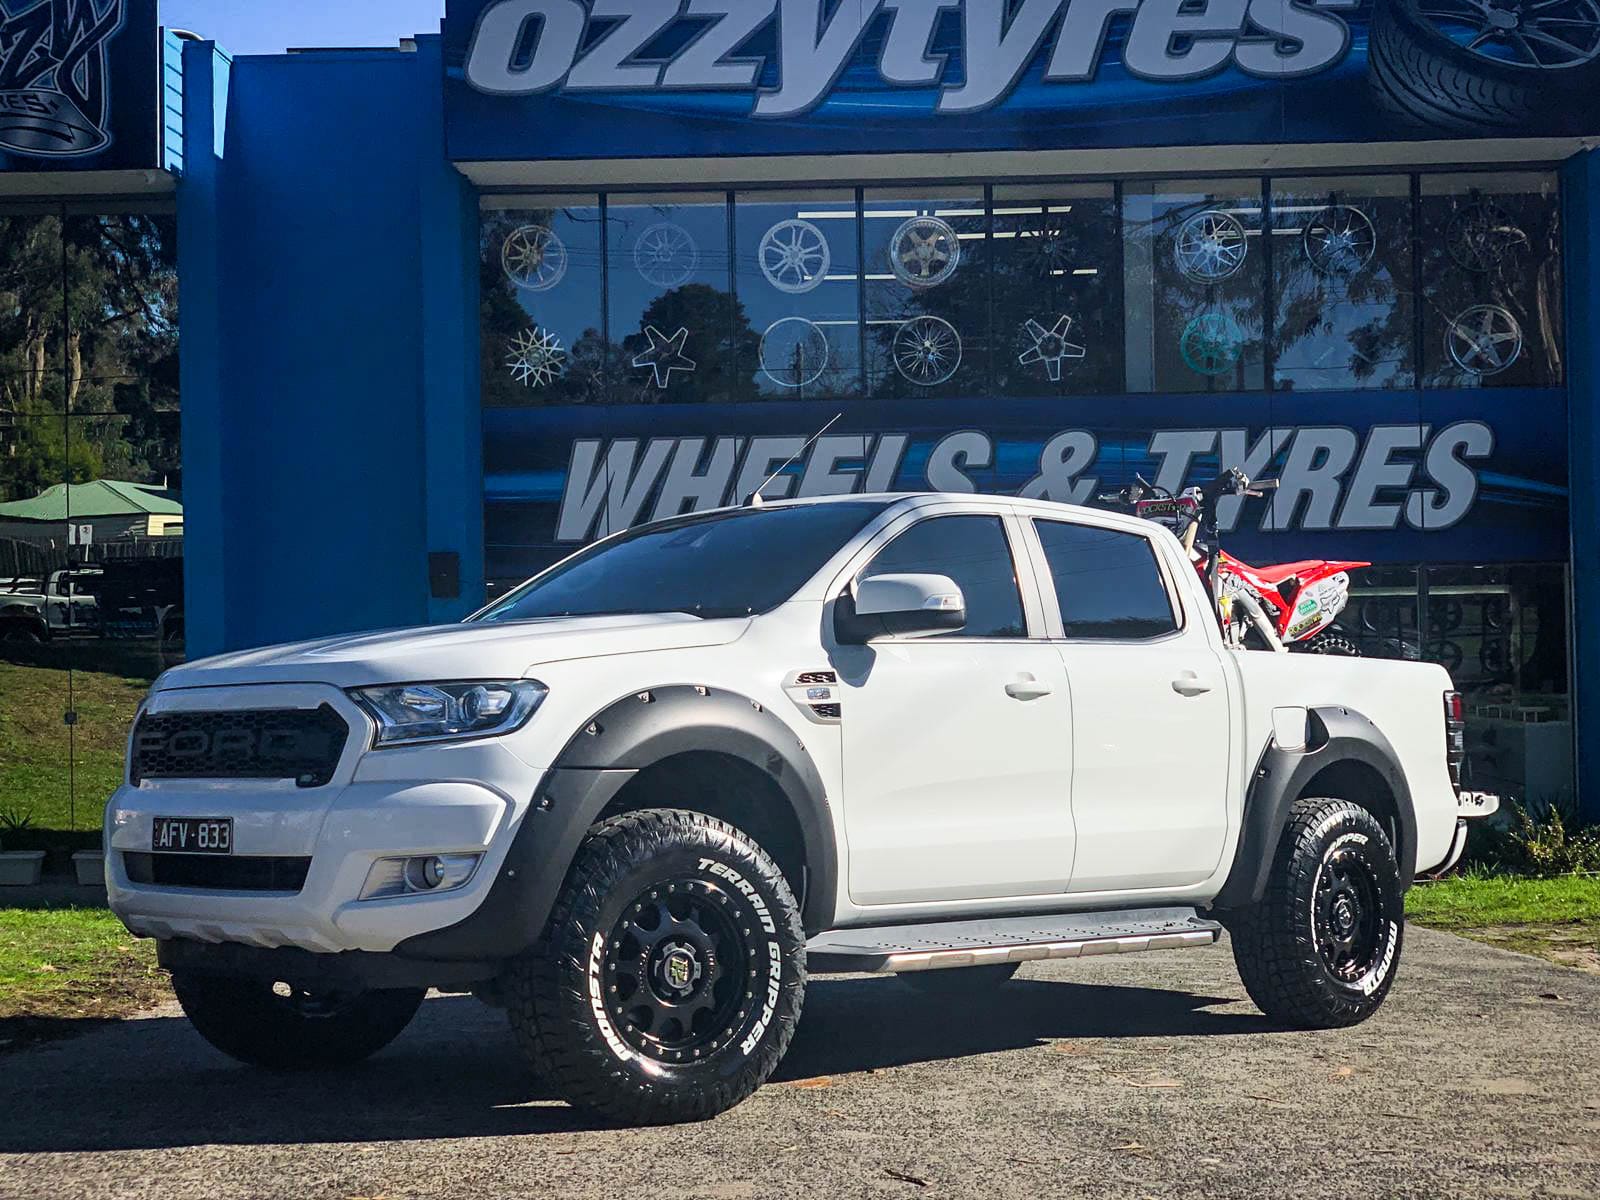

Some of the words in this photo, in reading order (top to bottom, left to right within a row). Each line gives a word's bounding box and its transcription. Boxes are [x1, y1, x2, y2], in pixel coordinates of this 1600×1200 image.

[1017, 429, 1096, 506] &
[1148, 421, 1494, 531] TYRES
[697, 857, 776, 934] TERRAIN
[739, 941, 782, 1056] GRIPPER
